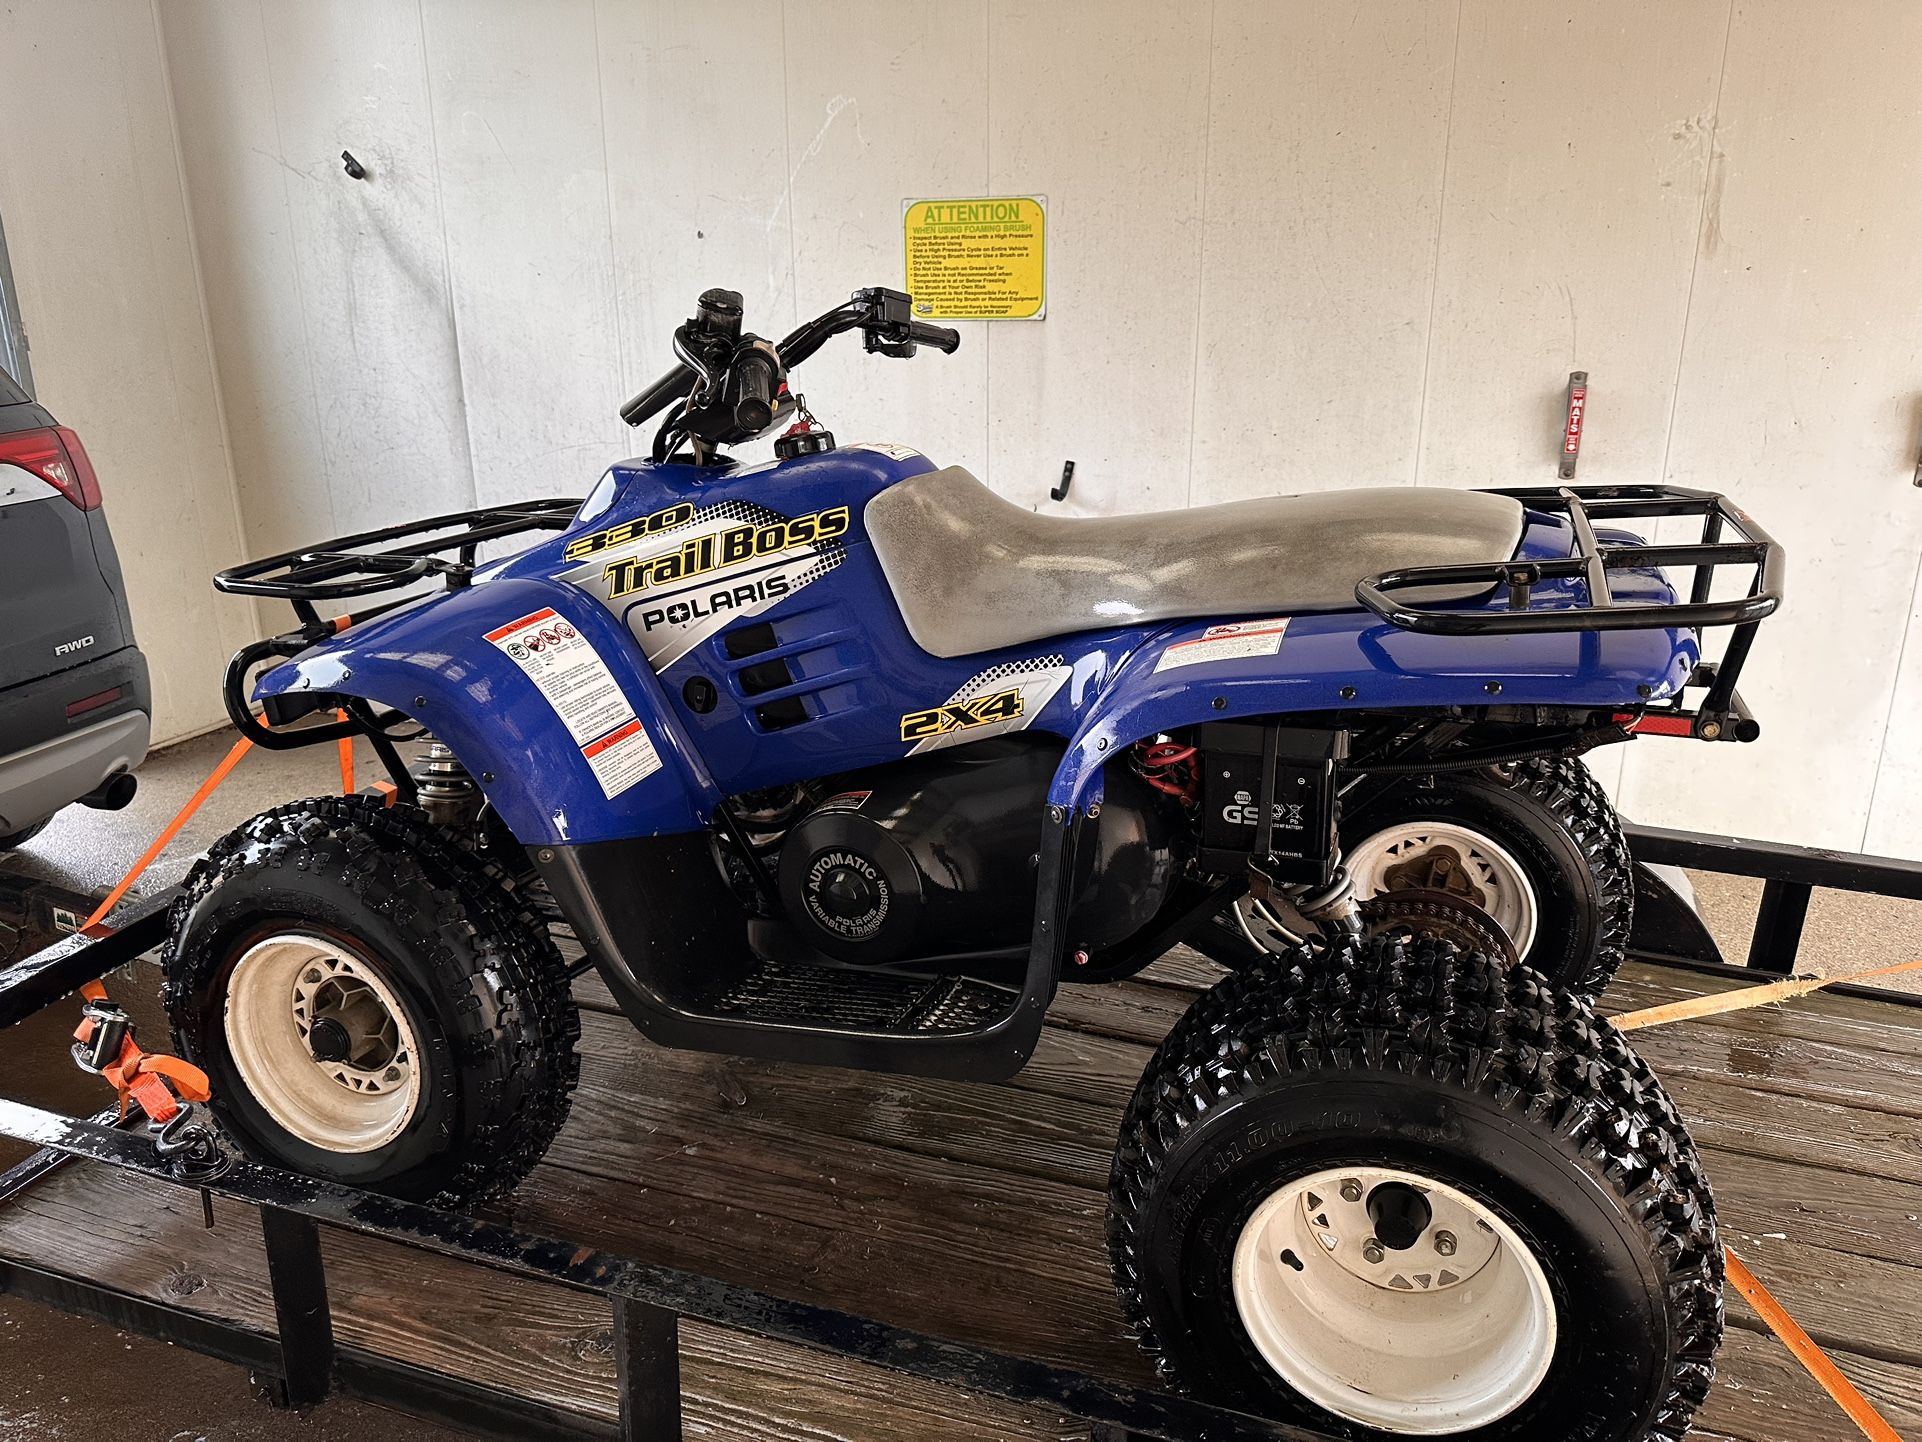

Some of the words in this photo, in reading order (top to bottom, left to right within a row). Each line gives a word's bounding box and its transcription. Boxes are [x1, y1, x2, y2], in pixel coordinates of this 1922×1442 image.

[924, 203, 1020, 222] ATTENTION
[1570, 399, 1582, 432] MATS
[562, 502, 694, 564] 330
[602, 532, 717, 600] Trail
[642, 575, 790, 632] POLARIS
[54, 635, 95, 657] AWD
[900, 688, 1024, 742] 2X4
[607, 730, 628, 744] WARNING
[809, 852, 876, 892] AUTOMATIC
[809, 895, 847, 934] VARIABLE
[850, 880, 888, 934] TRANSMISSION
[836, 908, 876, 926] POLARIS
